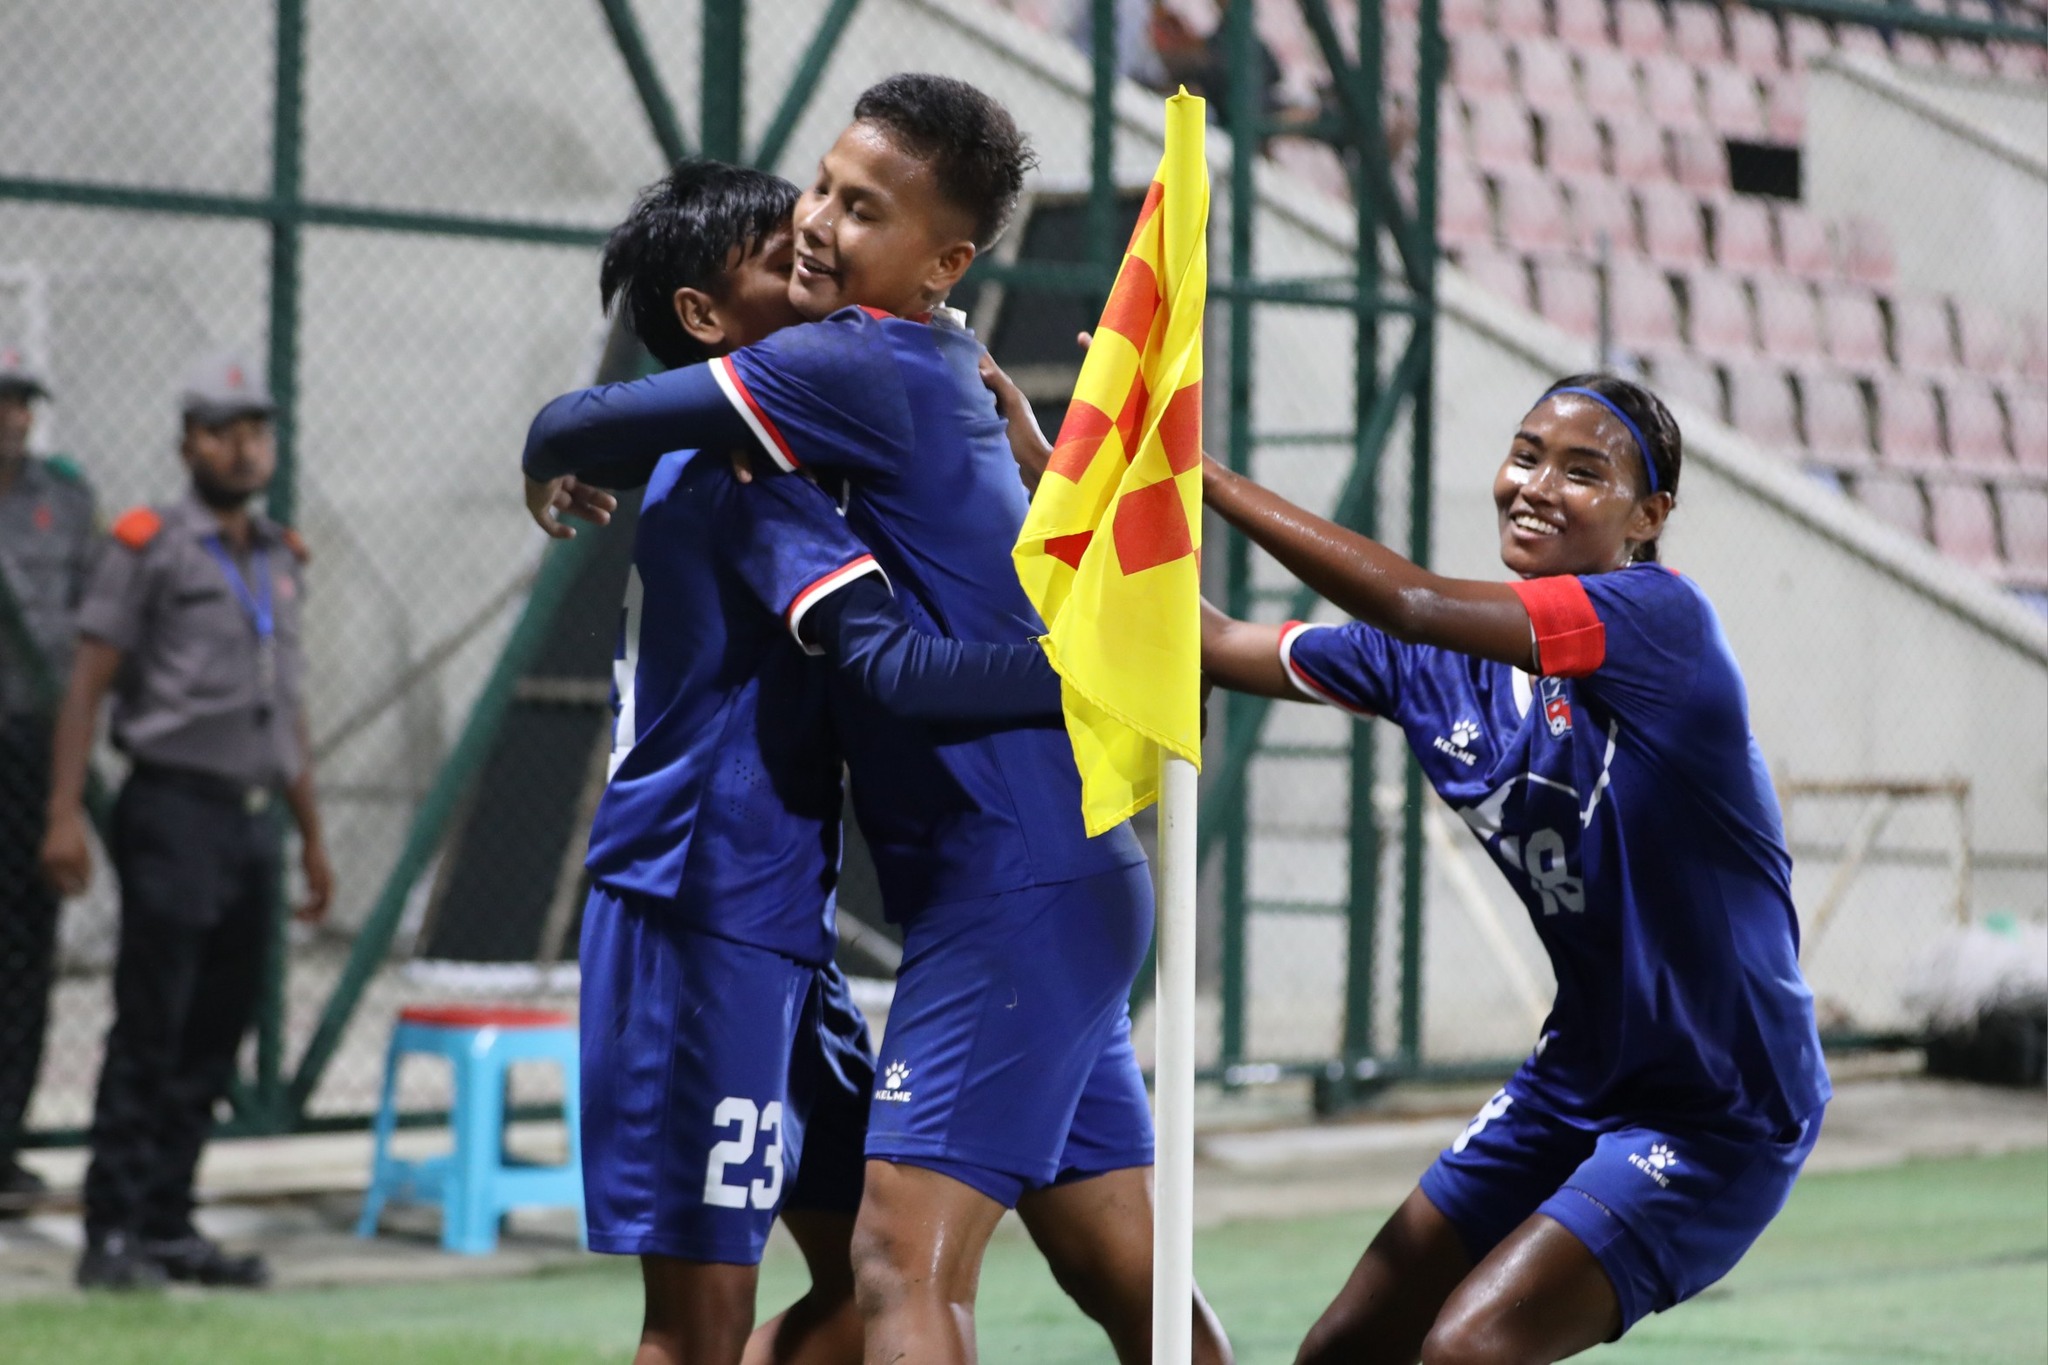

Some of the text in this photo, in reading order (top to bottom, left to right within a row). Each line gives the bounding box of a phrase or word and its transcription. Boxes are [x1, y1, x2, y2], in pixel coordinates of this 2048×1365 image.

[1433, 735, 1477, 765] KELME
[875, 1090, 912, 1103] KELME
[702, 1096, 784, 1210] 23
[1628, 1152, 1671, 1188] KELME
